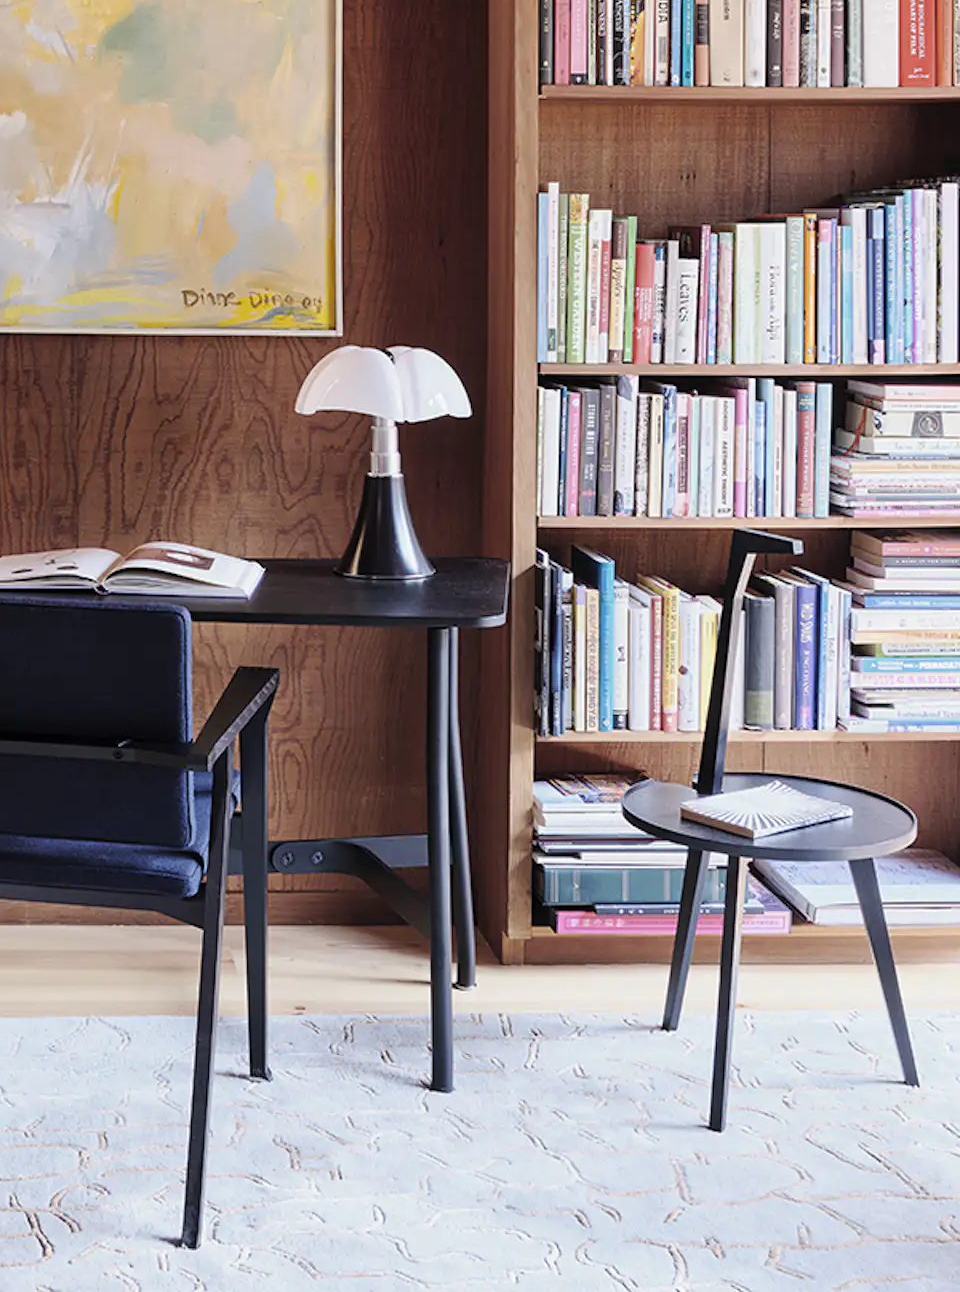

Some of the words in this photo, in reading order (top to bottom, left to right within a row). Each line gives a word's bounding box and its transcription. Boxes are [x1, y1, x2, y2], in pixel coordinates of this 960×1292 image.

[910, 34, 918, 54] FILM
[572, 238, 583, 296] WESTERN
[612, 261, 625, 299] Apples
[679, 273, 696, 322] Leaves
[571, 299, 582, 350] GARDEN
